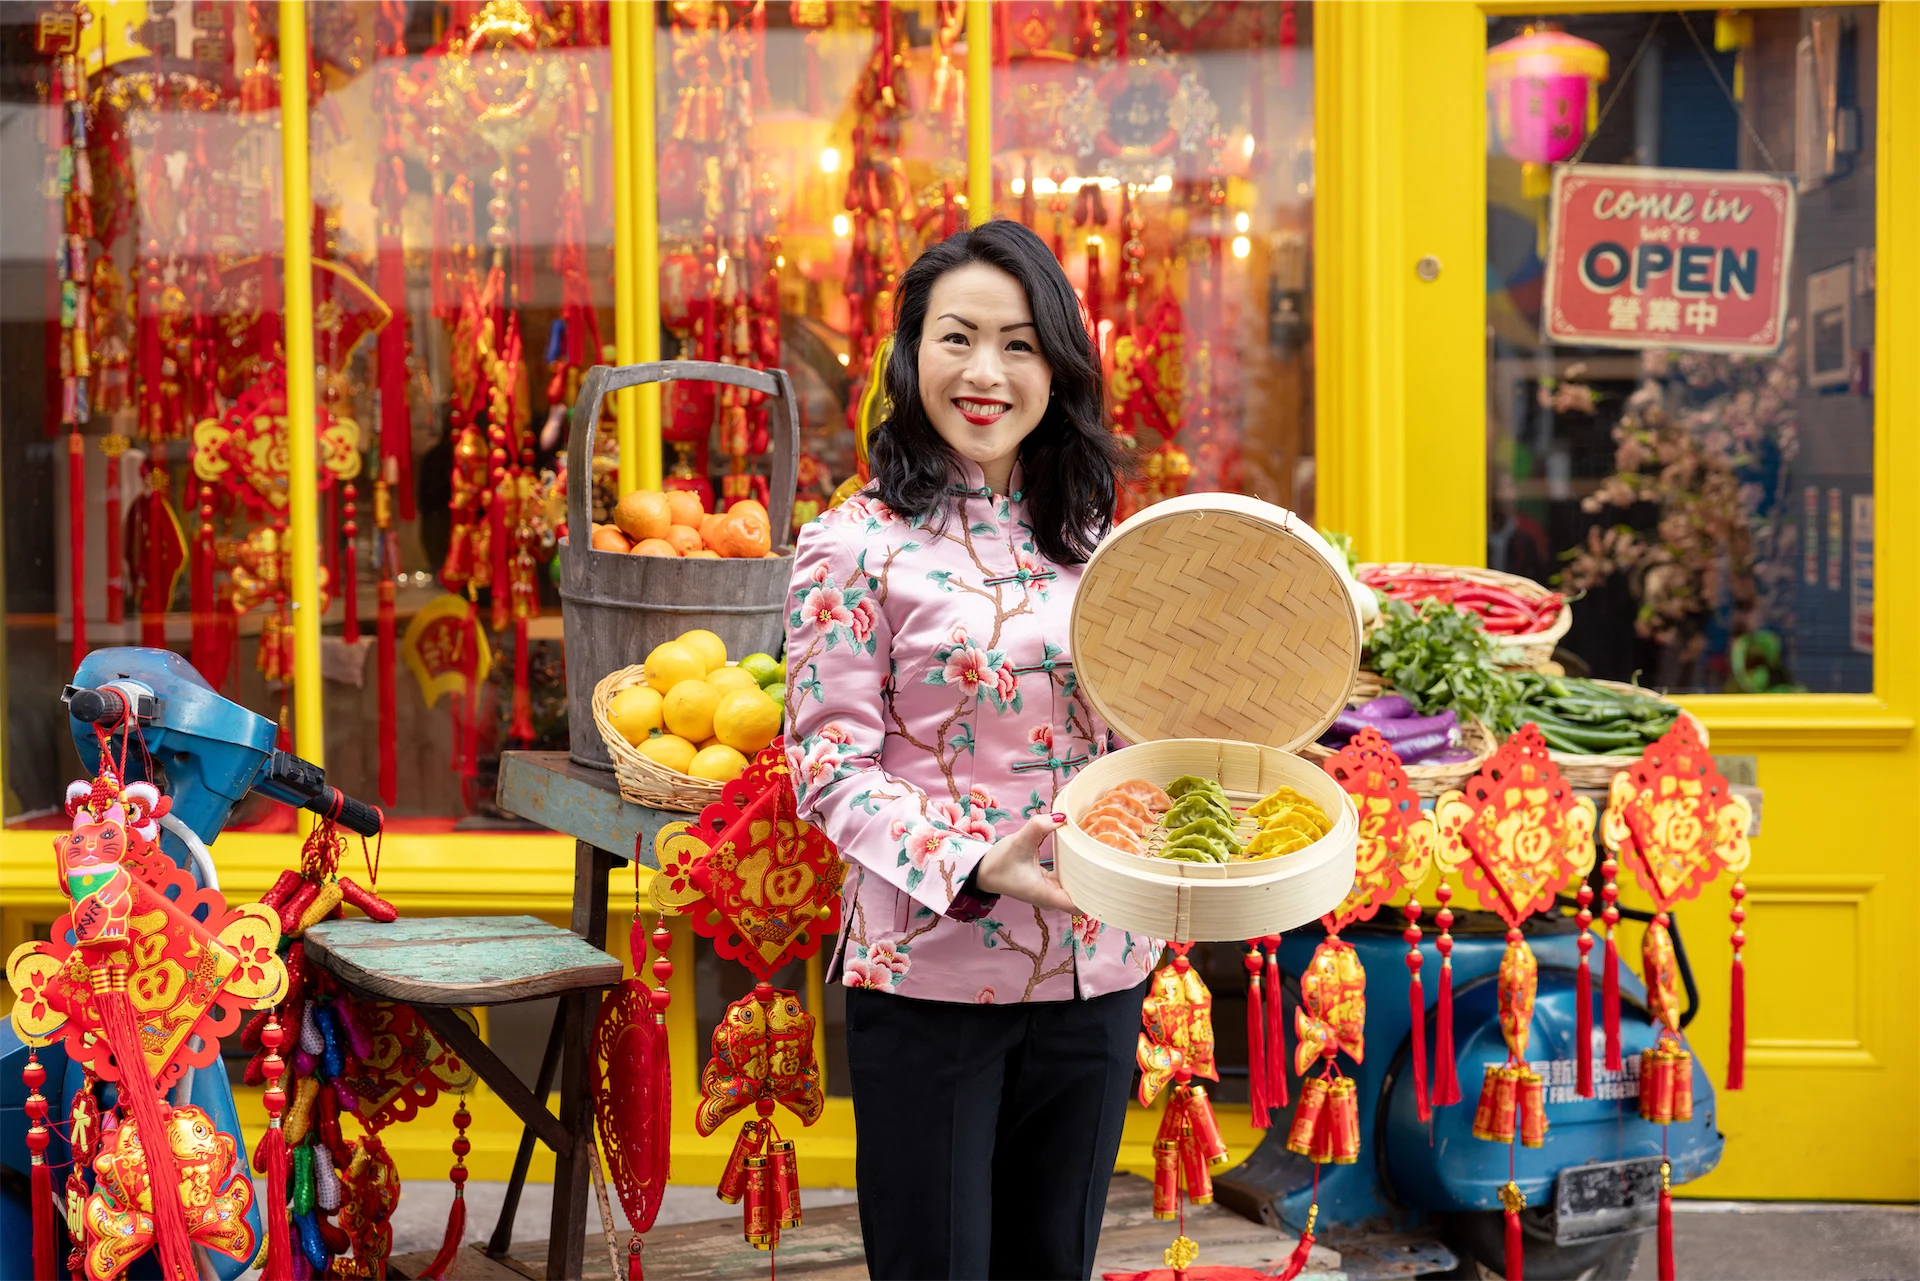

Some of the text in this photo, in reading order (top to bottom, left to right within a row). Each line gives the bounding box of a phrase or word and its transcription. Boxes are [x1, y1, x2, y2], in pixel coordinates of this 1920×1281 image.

[39, 12, 78, 52] 門
[1593, 188, 1753, 224] come in
[1640, 225, 1700, 242] we're
[1578, 242, 1758, 300] OPEN
[1608, 295, 1718, 334] 營業中
[1495, 787, 1552, 863] 福
[1651, 774, 1703, 851] 福
[735, 819, 816, 908] 福
[769, 1040, 800, 1076] 福
[71, 1100, 91, 1152] 大
[178, 1163, 213, 1208] 福
[67, 1189, 85, 1241] 利
